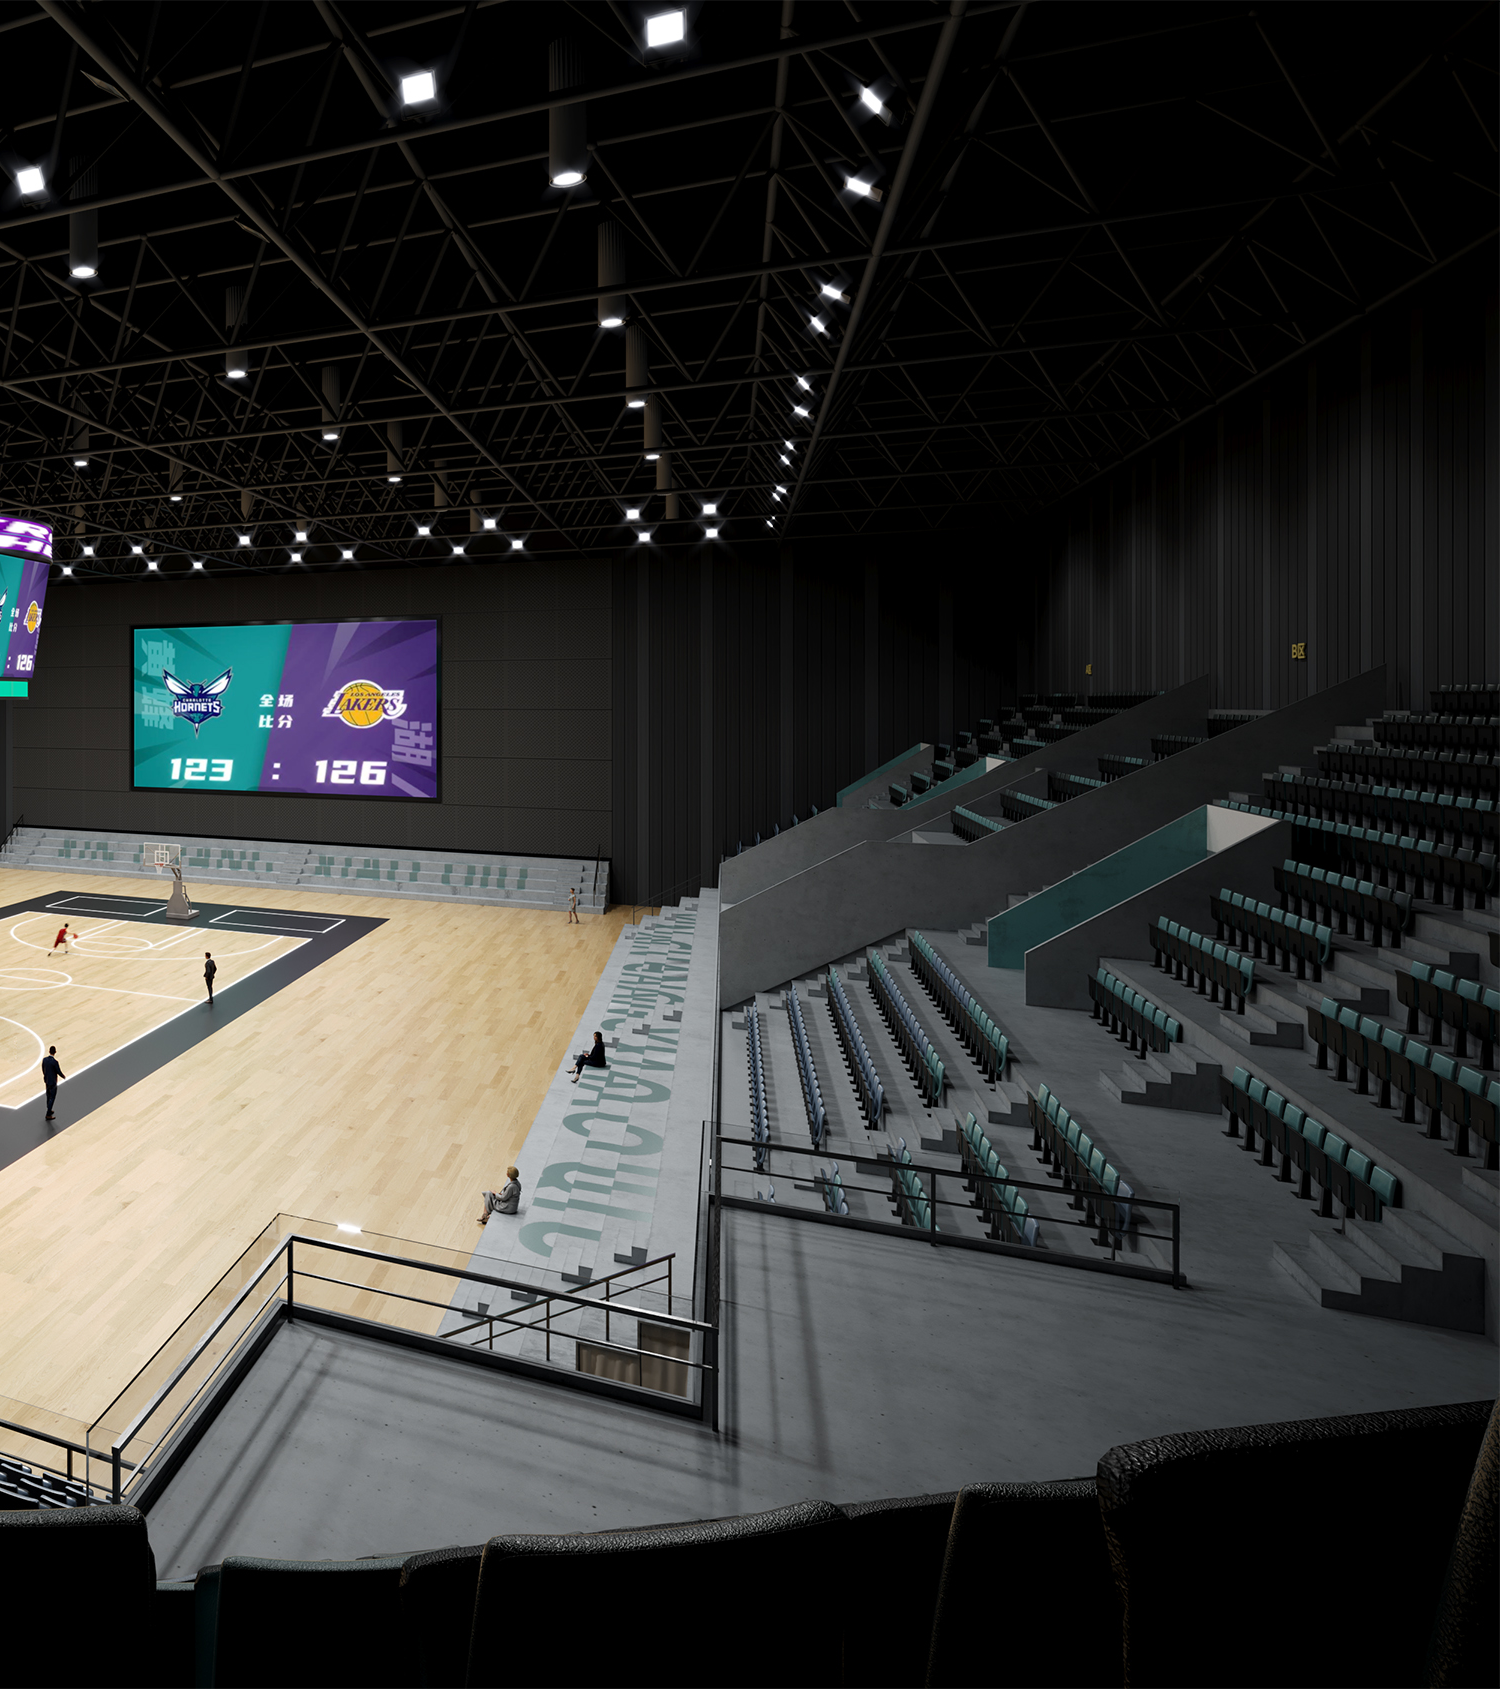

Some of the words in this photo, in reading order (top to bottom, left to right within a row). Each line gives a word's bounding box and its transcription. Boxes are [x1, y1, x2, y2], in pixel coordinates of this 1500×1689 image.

[1291, 642, 1306, 659] B区
[16, 654, 34, 671] 126
[174, 700, 220, 714] HORNETS
[329, 692, 400, 716] LAKERS
[258, 714, 293, 728] 比分
[170, 758, 234, 782] 123
[315, 760, 388, 785] 126
